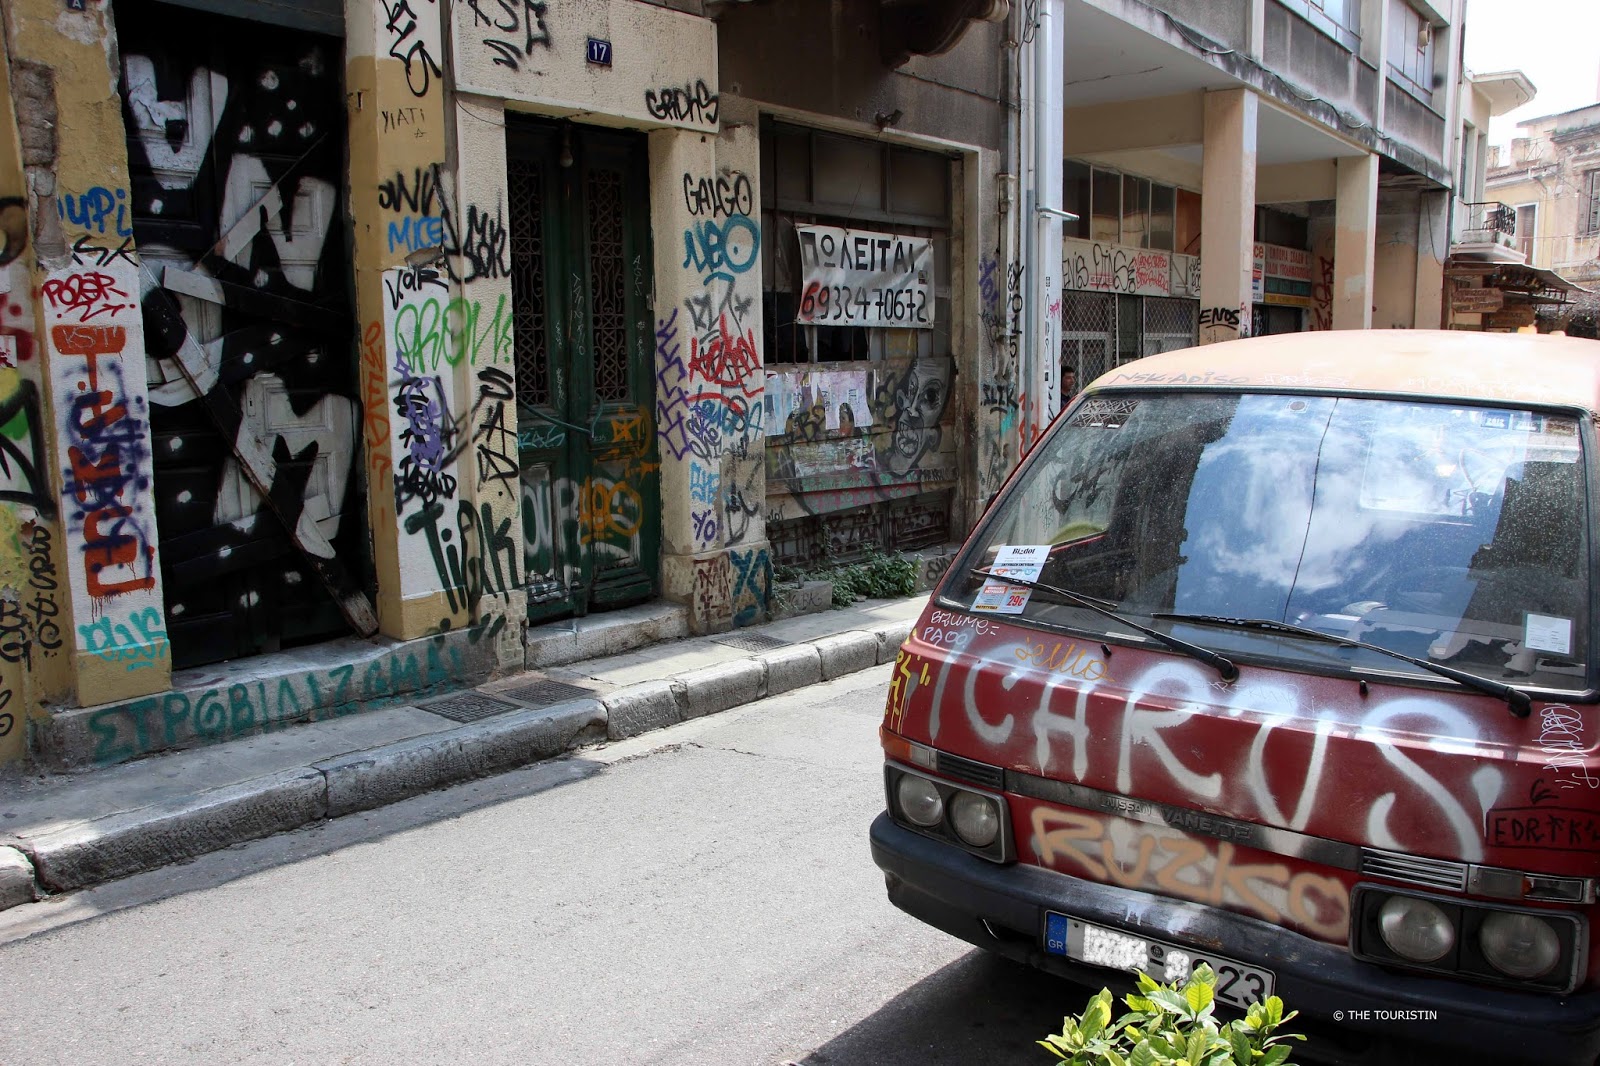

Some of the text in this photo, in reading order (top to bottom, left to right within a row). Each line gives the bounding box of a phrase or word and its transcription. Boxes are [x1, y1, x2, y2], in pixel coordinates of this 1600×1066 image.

[592, 43, 607, 62] 17
[800, 231, 915, 274] ΠΩΛΕΙΤΑΙ
[801, 281, 927, 322] 6932470672
[1107, 796, 1152, 817] NISSAN
[1048, 939, 1063, 950] GR
